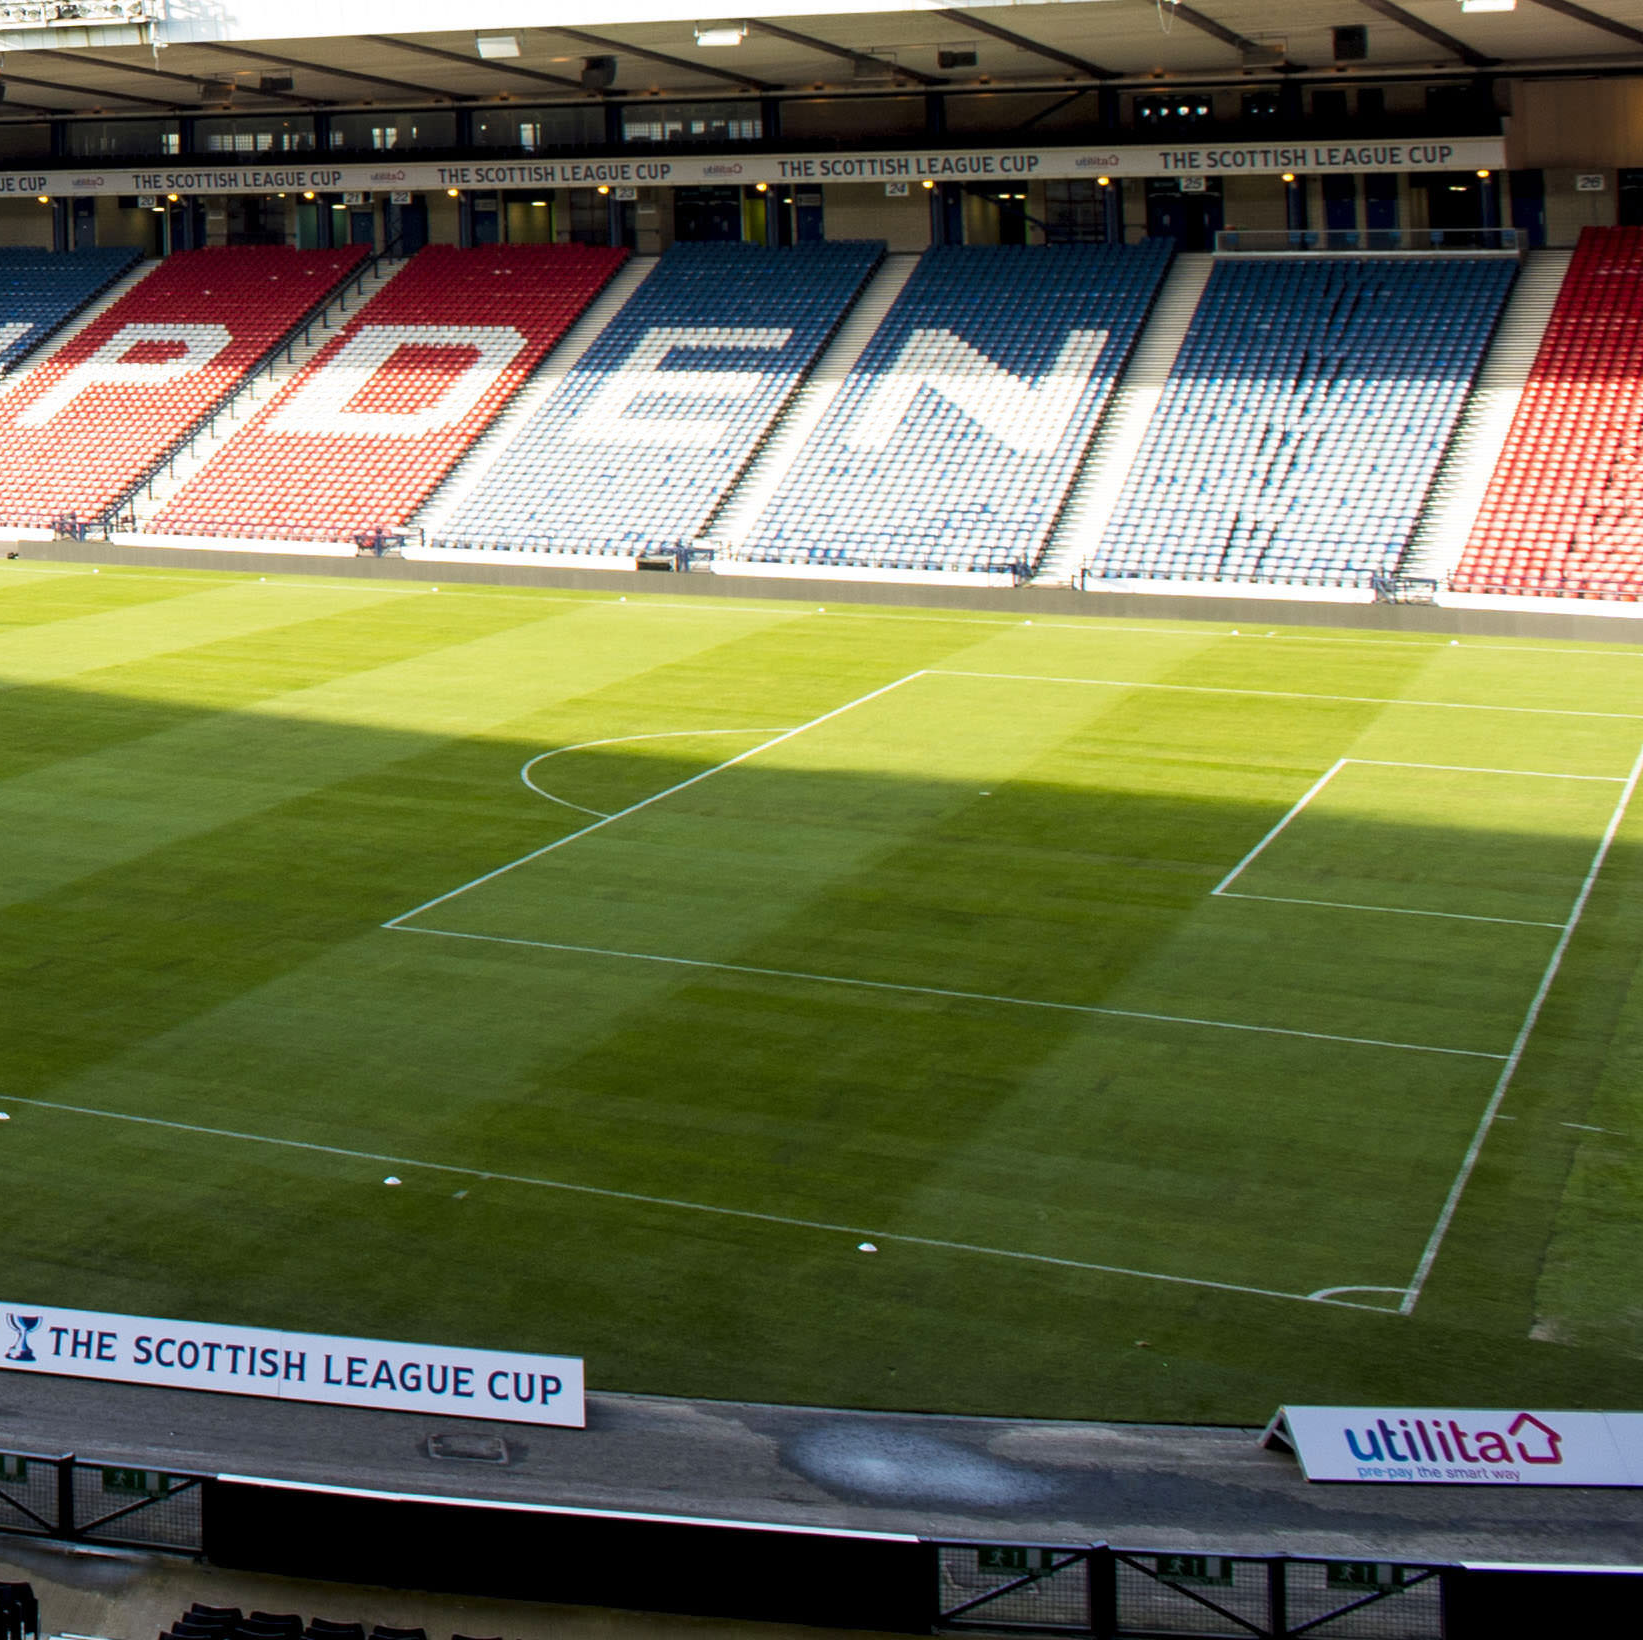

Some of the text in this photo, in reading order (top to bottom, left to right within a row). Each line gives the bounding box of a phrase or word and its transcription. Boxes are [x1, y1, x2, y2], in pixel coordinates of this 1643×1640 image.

[1159, 145, 1452, 169] THE SCOTTISH LEAGUE CUP
[437, 163, 671, 184] THE SCOTTISH LEAGUE CUP
[777, 155, 1039, 177] THE SCOTTISH LEAGUE CUP
[19, 177, 47, 192] CUP
[132, 171, 342, 189] THE SCOTTISH LEAGUE CUP
[1184, 178, 1202, 189] 25
[1580, 176, 1601, 188] 26
[619, 188, 634, 198] 23
[890, 183, 906, 194] 24
[141, 197, 154, 206] 20
[347, 193, 360, 203] 21
[395, 192, 408, 202] 22
[49, 1326, 563, 1405] THE SCOTTISH LEAGUE CUP
[1344, 1418, 1515, 1464] utilita
[1357, 1466, 1521, 1482] pre-pay the smart way
